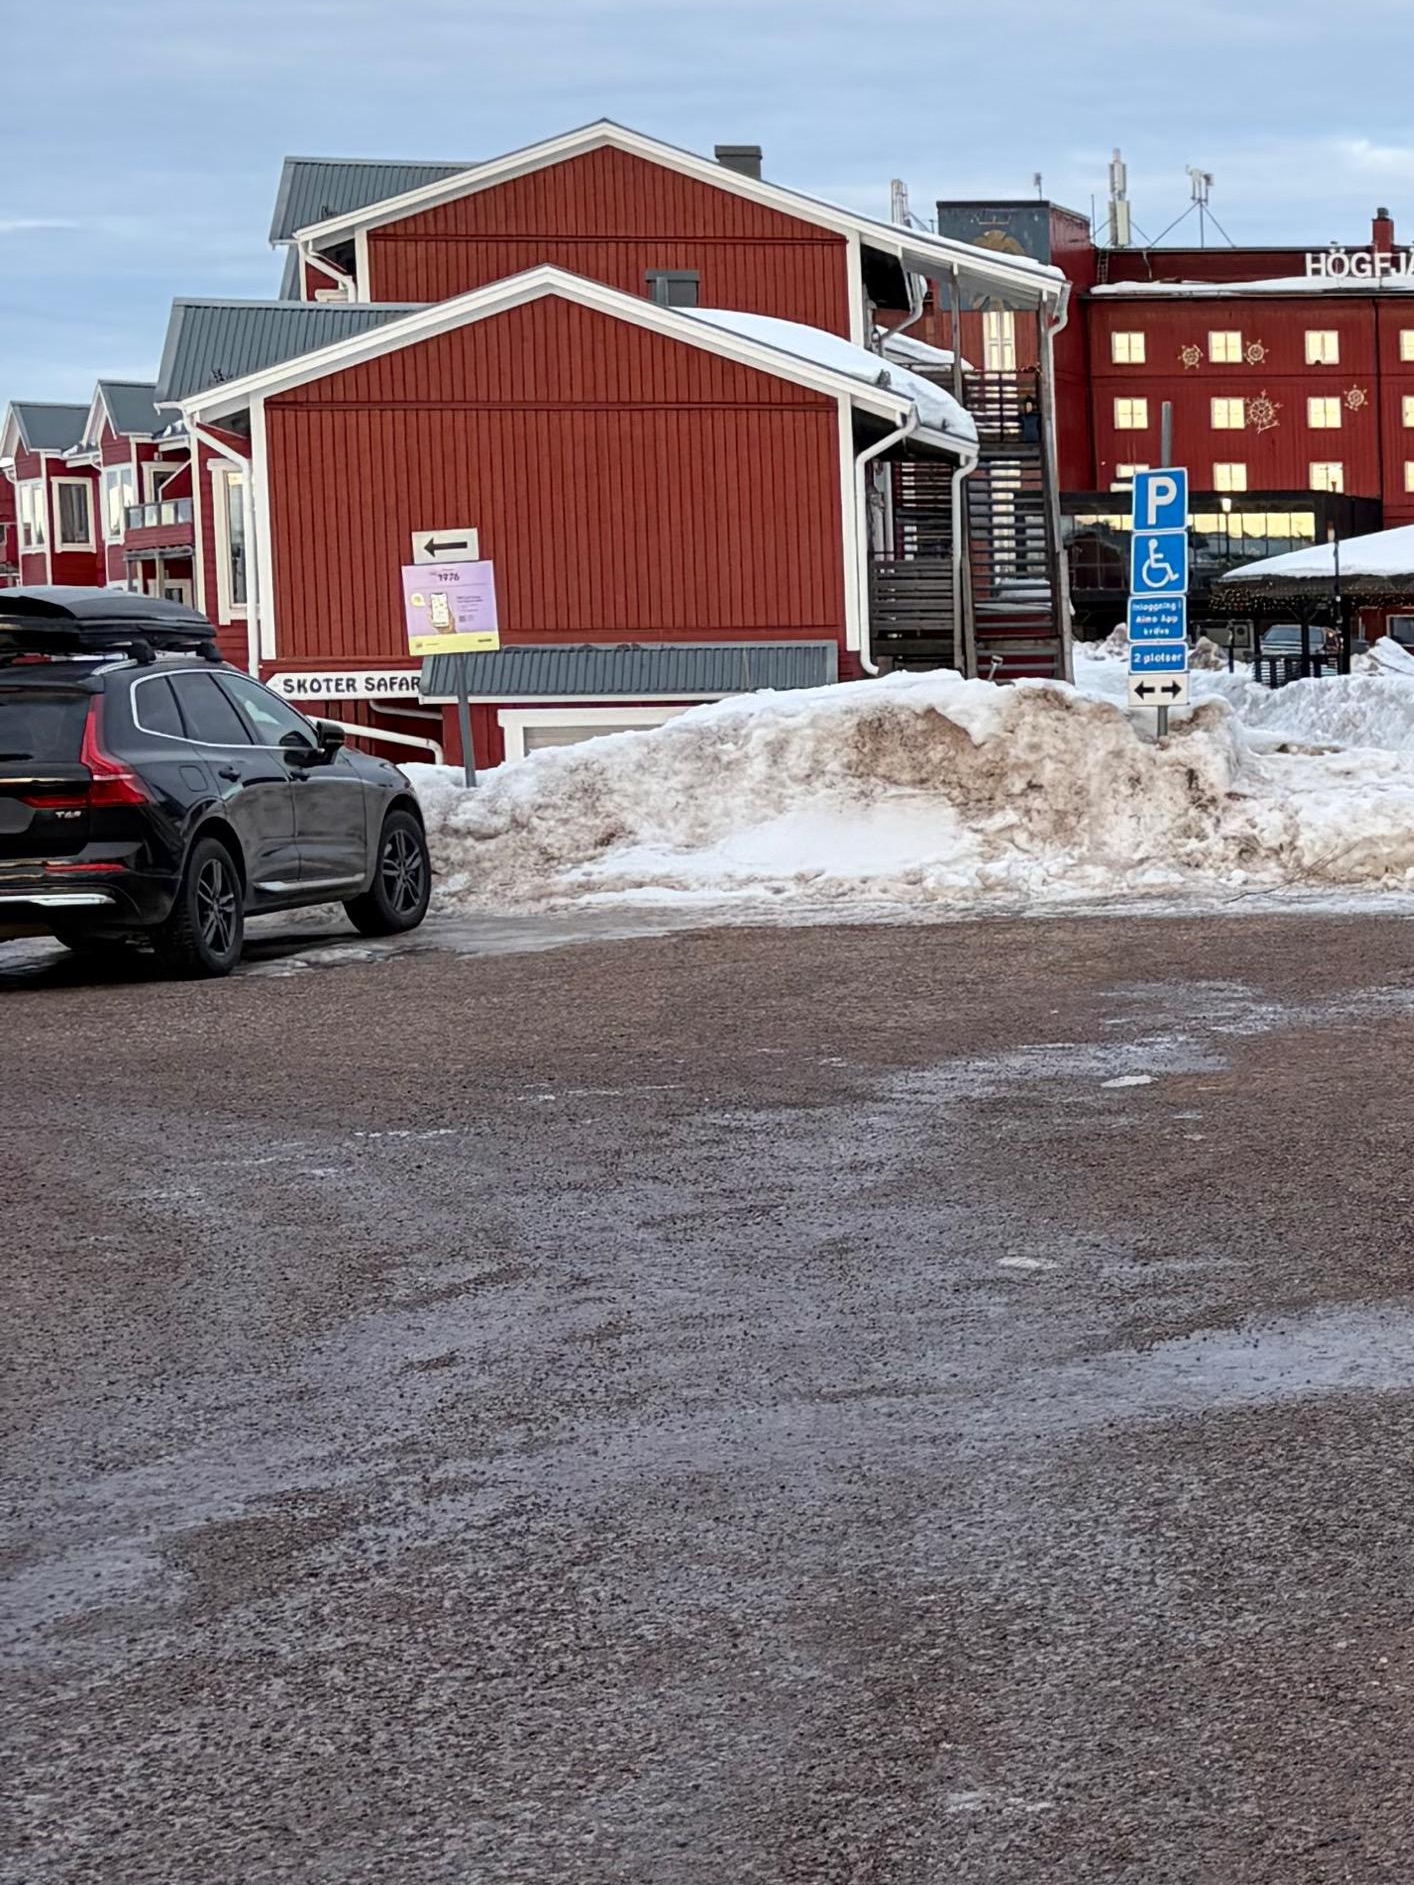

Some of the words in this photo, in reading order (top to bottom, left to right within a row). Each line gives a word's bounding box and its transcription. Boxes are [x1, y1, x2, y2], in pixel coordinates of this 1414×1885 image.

[1147, 476, 1178, 525] P
[1133, 653, 1140, 663] 2
[283, 678, 357, 694] SKOTER
